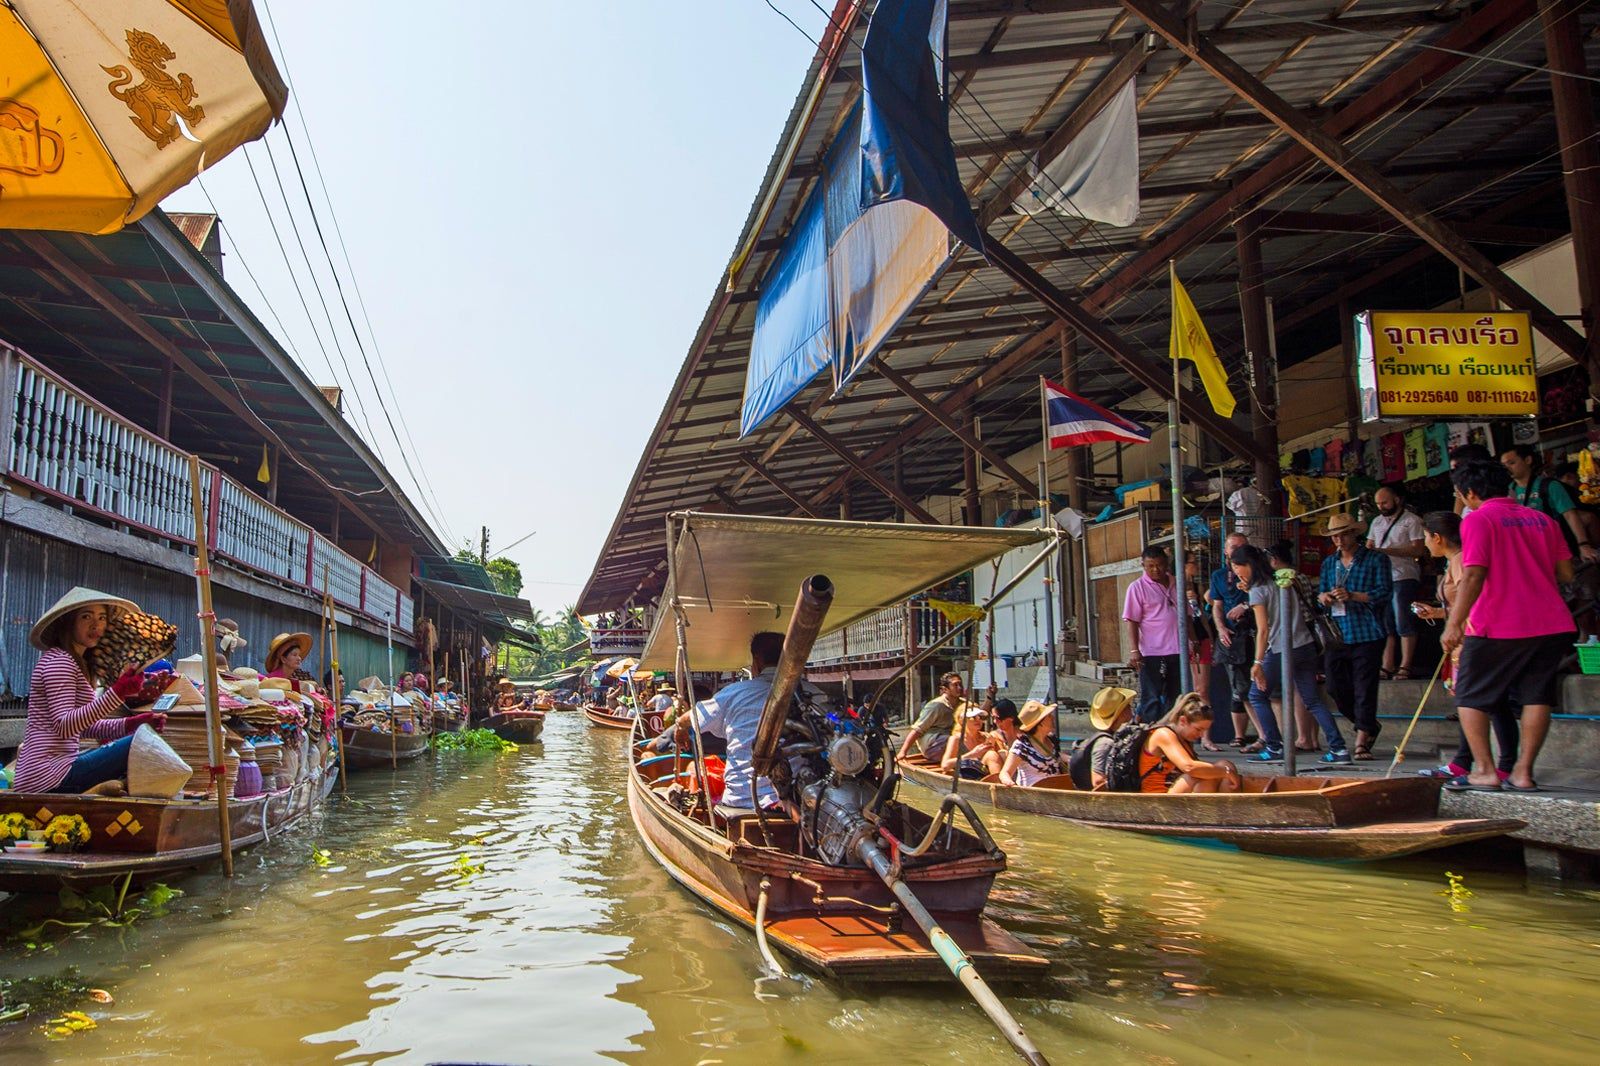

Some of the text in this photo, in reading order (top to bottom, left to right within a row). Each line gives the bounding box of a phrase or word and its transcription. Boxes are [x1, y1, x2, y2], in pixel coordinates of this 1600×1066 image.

[1383, 316, 1519, 354] จุดลงเรือ
[1379, 357, 1533, 376] เรือพาย เรือยนต์
[1381, 390, 1537, 403] 081-2925640 087-1111624
